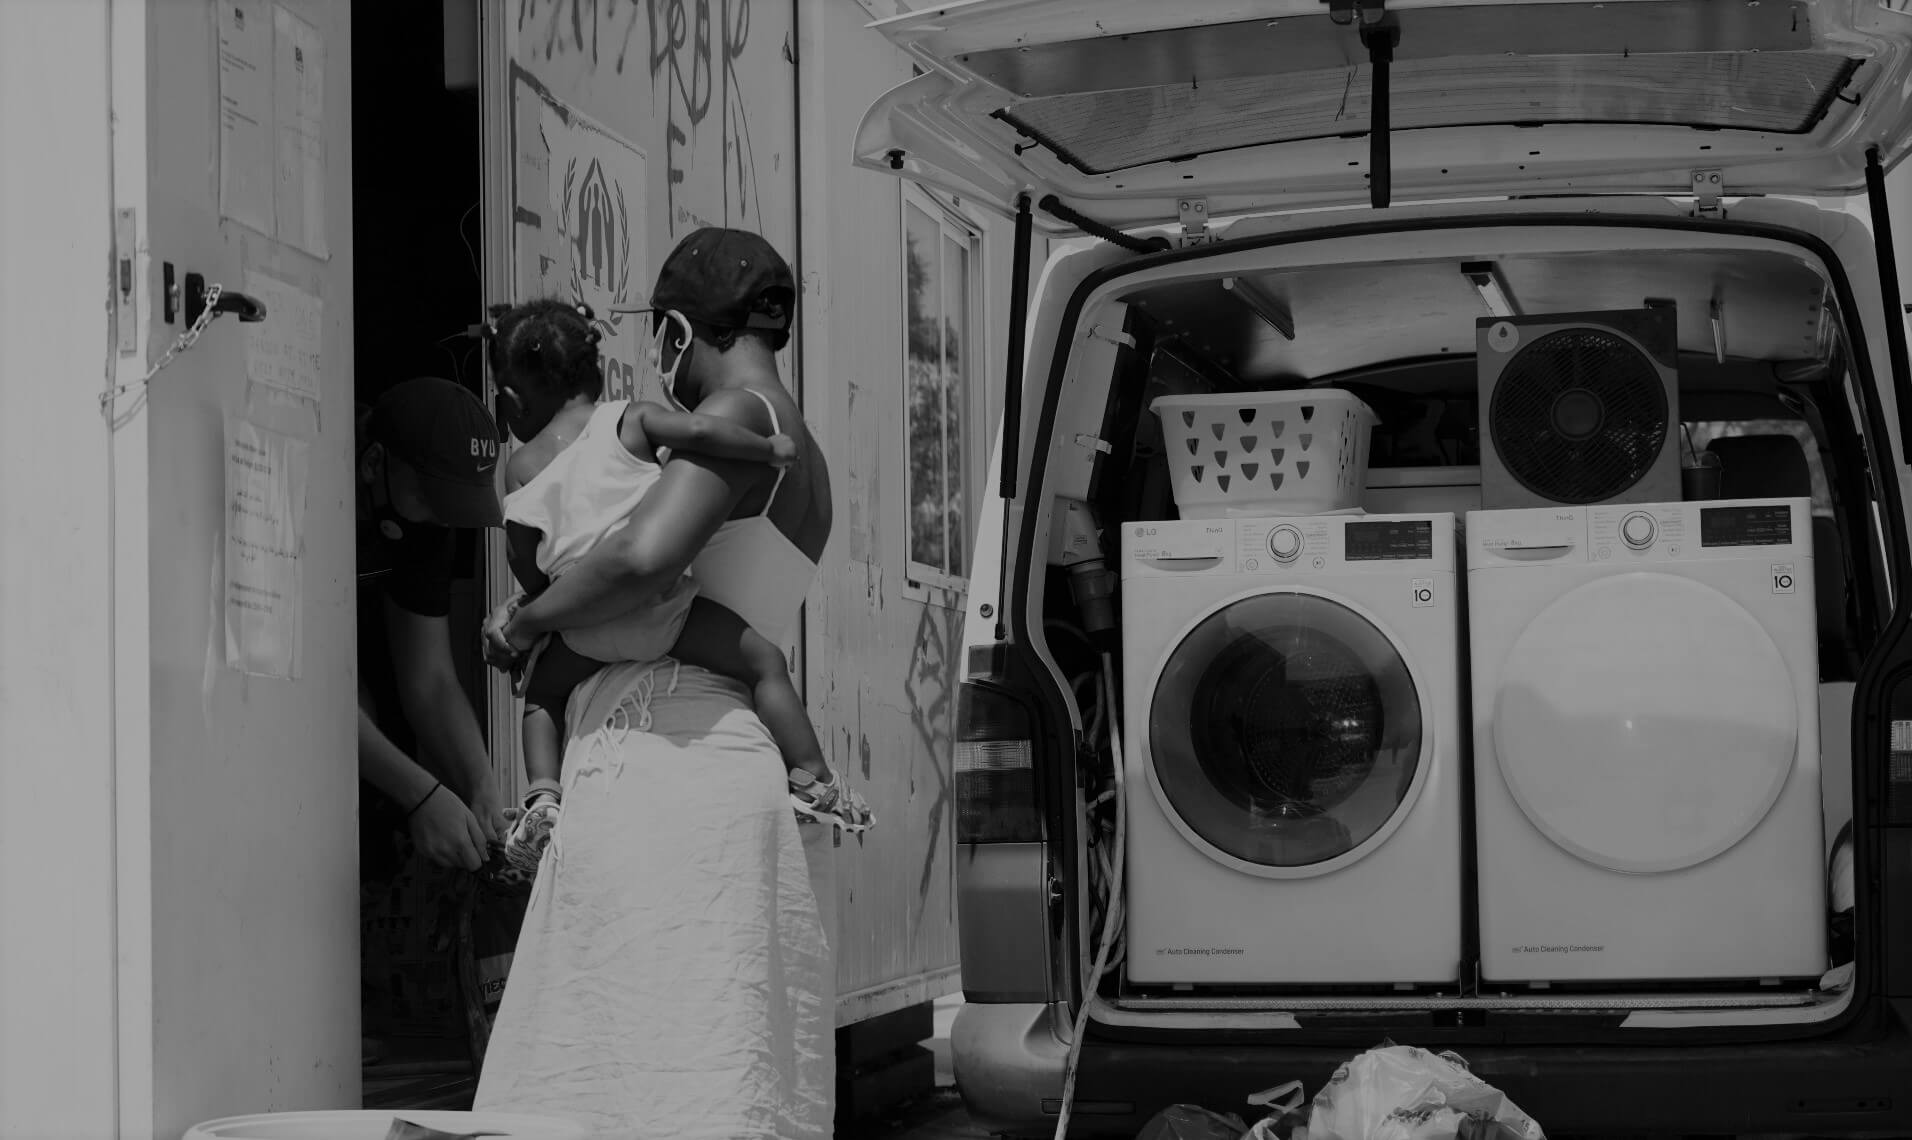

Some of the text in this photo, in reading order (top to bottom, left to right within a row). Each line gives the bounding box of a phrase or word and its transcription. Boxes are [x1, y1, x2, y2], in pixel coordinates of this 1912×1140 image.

[470, 438, 496, 458] BYU
[1183, 947, 1210, 956] Cleaning
[1523, 945, 1539, 953] Auto
[1540, 945, 1569, 954] Cleaning
